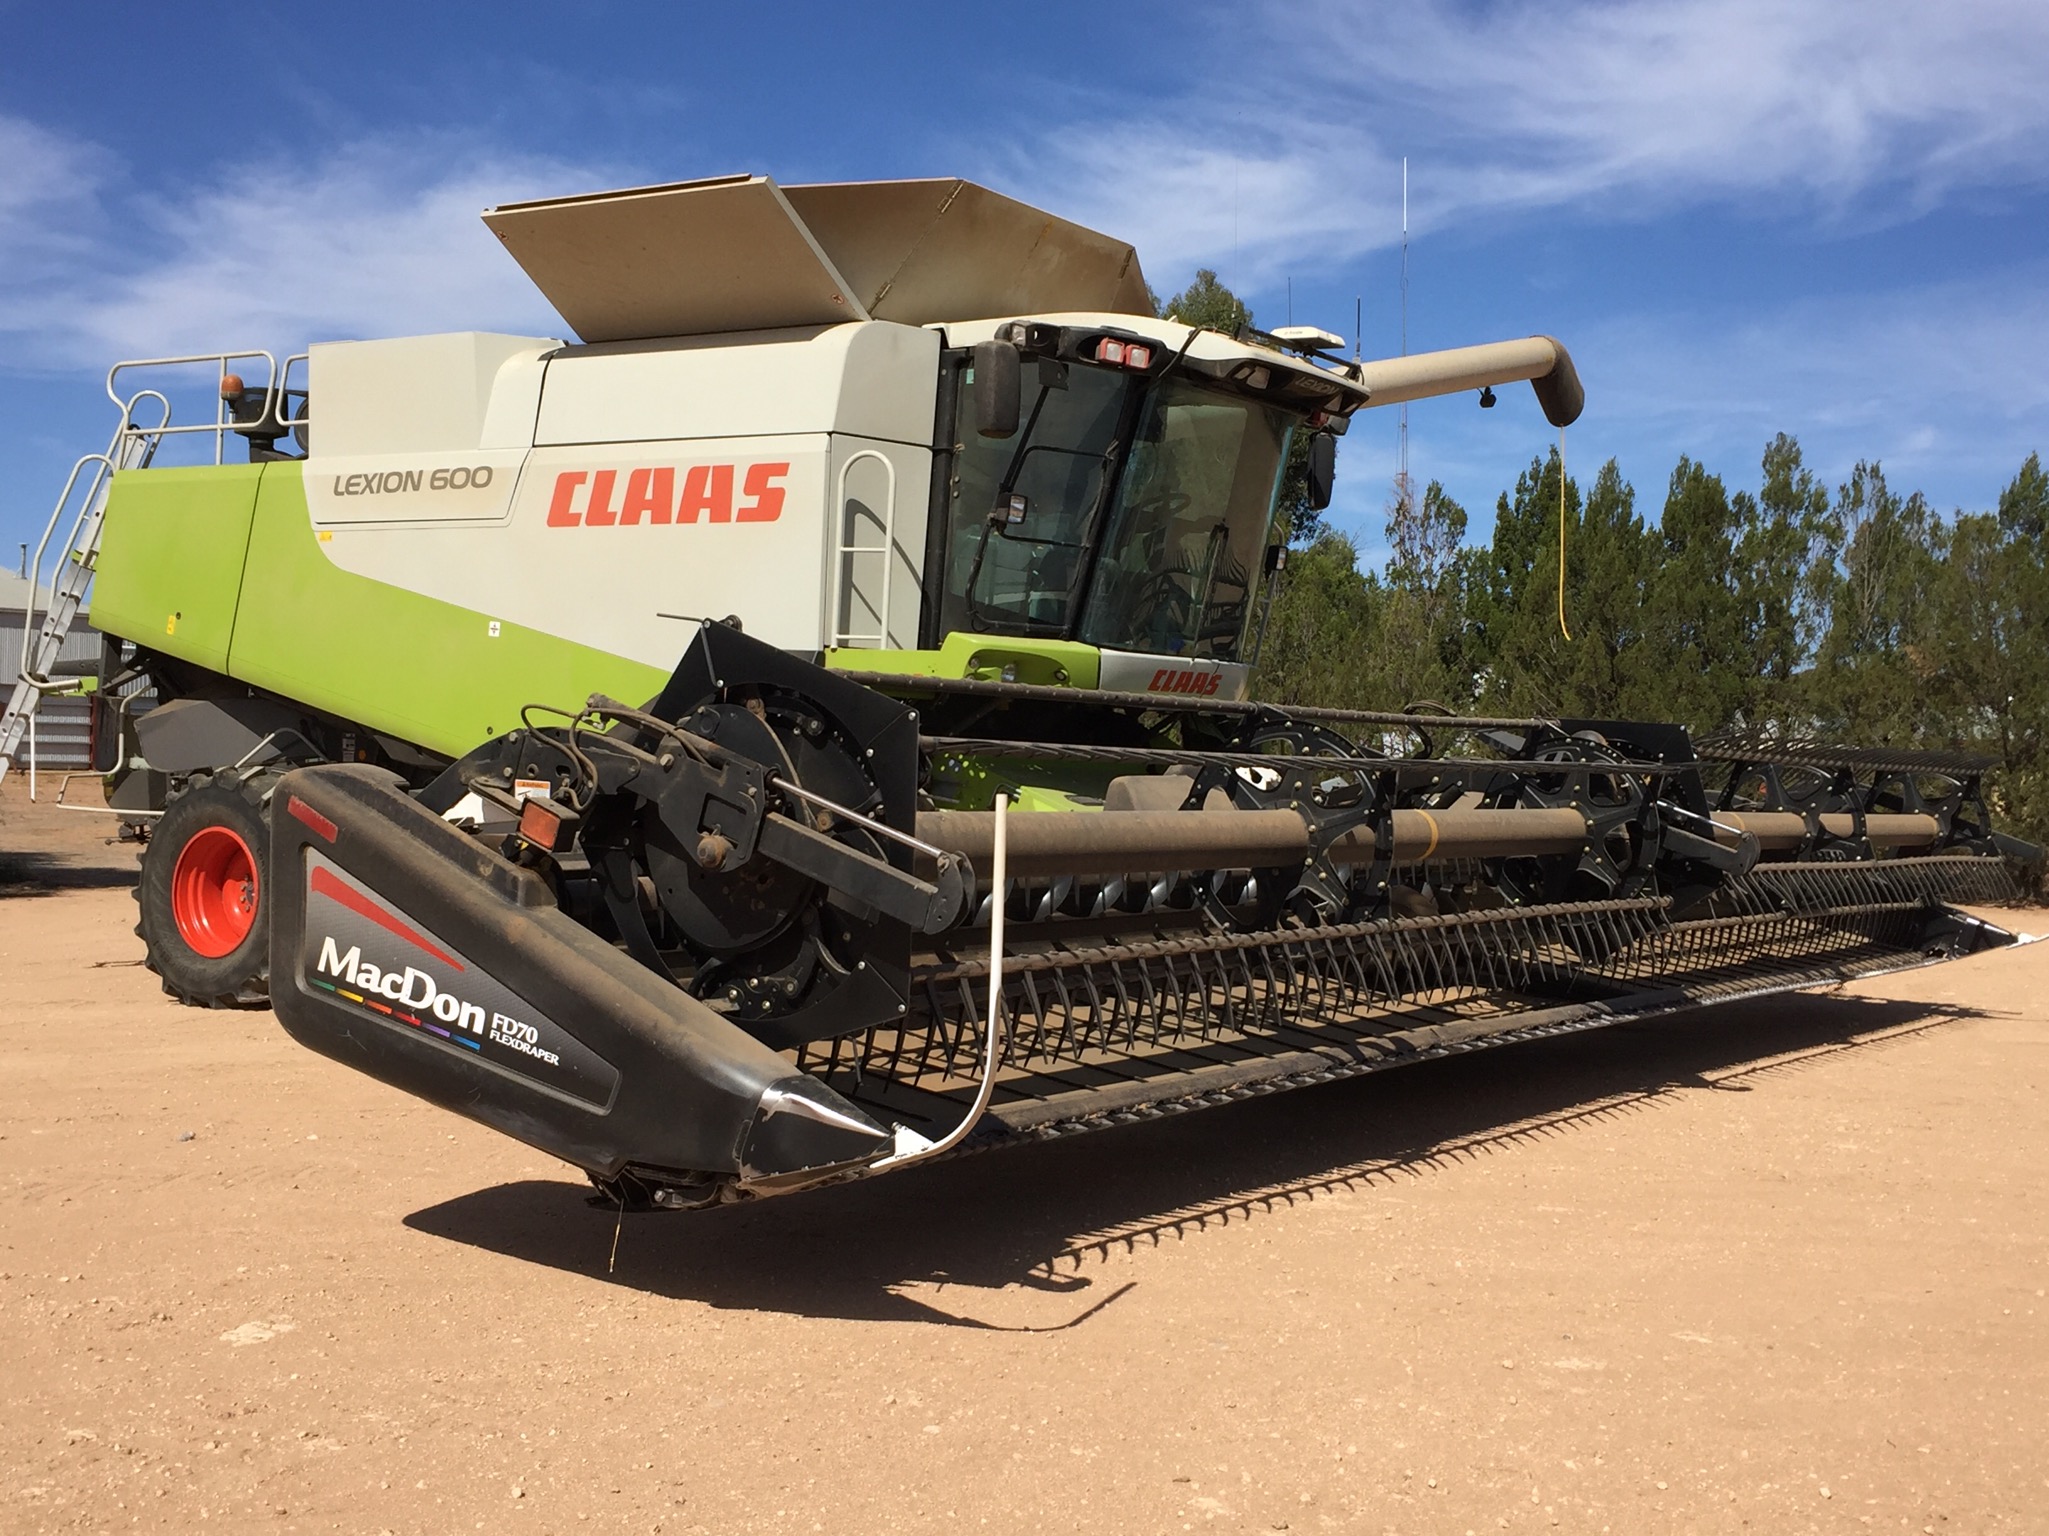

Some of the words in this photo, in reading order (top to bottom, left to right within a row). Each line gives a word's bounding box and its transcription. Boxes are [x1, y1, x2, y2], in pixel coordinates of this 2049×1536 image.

[333, 470, 424, 496] LEXION
[429, 466, 493, 490] 600
[547, 462, 790, 527] CLAAS
[1147, 669, 1222, 695] CLAAS
[317, 936, 486, 1034] MacDon
[491, 1012, 539, 1044] FD70
[489, 1029, 560, 1066] FLEXDRAPER
